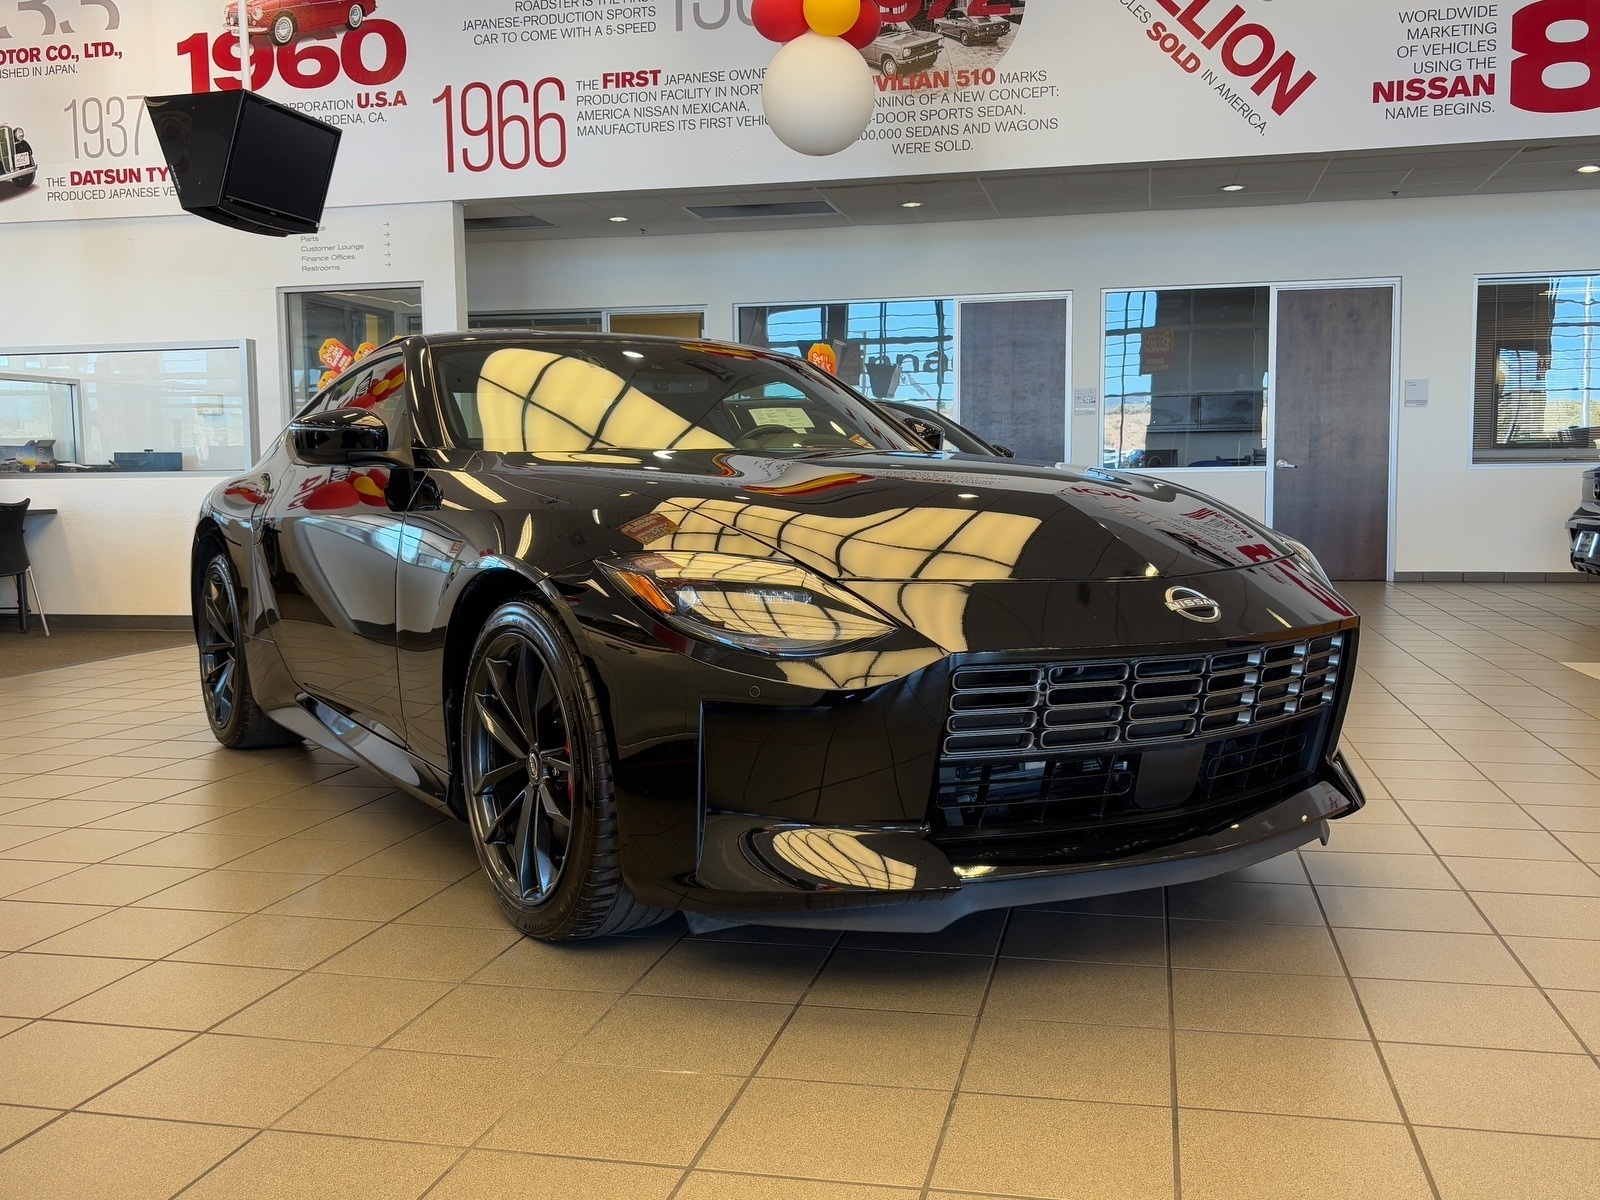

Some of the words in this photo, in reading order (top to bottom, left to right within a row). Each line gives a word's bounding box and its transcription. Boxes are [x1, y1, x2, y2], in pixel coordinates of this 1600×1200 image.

[515, 0, 579, 12] ROADSTER
[1398, 4, 1498, 23] WORLDWIDE
[462, 10, 603, 31] JAPANESE-PRODUCTION
[606, 6, 656, 20] SPORTS
[474, 33, 498, 45] CAR
[501, 32, 517, 43] TO
[521, 29, 557, 42] COME
[560, 26, 591, 39] WITH
[594, 25, 603, 36] A
[606, 22, 656, 35] 5-SPEED
[1407, 22, 1497, 40] MARKETING
[46, 45, 79, 62] CO.,
[84, 42, 122, 59] LTD.,
[176, 18, 407, 94] 1960
[1397, 45, 1418, 58] OF
[1422, 39, 1497, 56] VEHICLES
[32, 67, 42, 77] IN
[45, 64, 78, 76] JAPAN.
[1413, 59, 1462, 74] USING
[1467, 56, 1497, 70] THE
[576, 80, 599, 91] THE
[602, 70, 661, 89] FIRST
[664, 71, 725, 85] JAPANESE
[729, 68, 768, 80] OWNE
[872, 70, 949, 92] VILIAN
[956, 67, 996, 87] 510
[1000, 70, 1047, 84] MARKS
[1146, 21, 1201, 74] SOLD
[1201, 68, 1218, 86] IN
[1213, 83, 1266, 136] AMERICA.
[1372, 73, 1496, 104] NISSAN
[357, 90, 407, 108] U.S.A
[577, 91, 657, 106] PRODUCTION
[660, 87, 711, 101] FACILITY
[715, 87, 727, 97] IN
[730, 84, 763, 97] NORT
[919, 93, 938, 106] OF
[940, 92, 950, 104] A
[953, 90, 985, 103] NEW
[989, 86, 1059, 101] CONCEPT:
[368, 112, 387, 123] CA.
[576, 108, 630, 122] AMERICA
[634, 105, 679, 118] NISSAN
[682, 101, 750, 114] MEXICANA,
[869, 111, 916, 124] -DOOR
[919, 107, 974, 121] SPORTS
[977, 104, 1026, 117] SEDAN.
[1385, 105, 1429, 120] NAME
[1433, 100, 1495, 117] BEGINS.
[64, 96, 148, 159] 1937
[432, 77, 567, 173] 1966
[577, 120, 675, 136] MANUFACTURES
[678, 119, 696, 130] ITS
[700, 117, 733, 129] FIRST
[857, 128, 902, 142] 00,000
[905, 123, 959, 138] SEDANS
[963, 122, 991, 135] AND
[995, 118, 1059, 133] WAGONS
[891, 142, 931, 155] WERE
[934, 139, 974, 152] SOLD.
[46, 177, 66, 188] THE
[70, 168, 141, 187] DATSUN
[146, 167, 171, 182] TY
[47, 189, 106, 202] PRODUCED
[108, 187, 160, 200] JAPANESE
[300, 235, 319, 243] Parts
[301, 245, 336, 253] Customer
[302, 264, 340, 272] Restrooms
[1168, 598, 1219, 610] NISSAN
